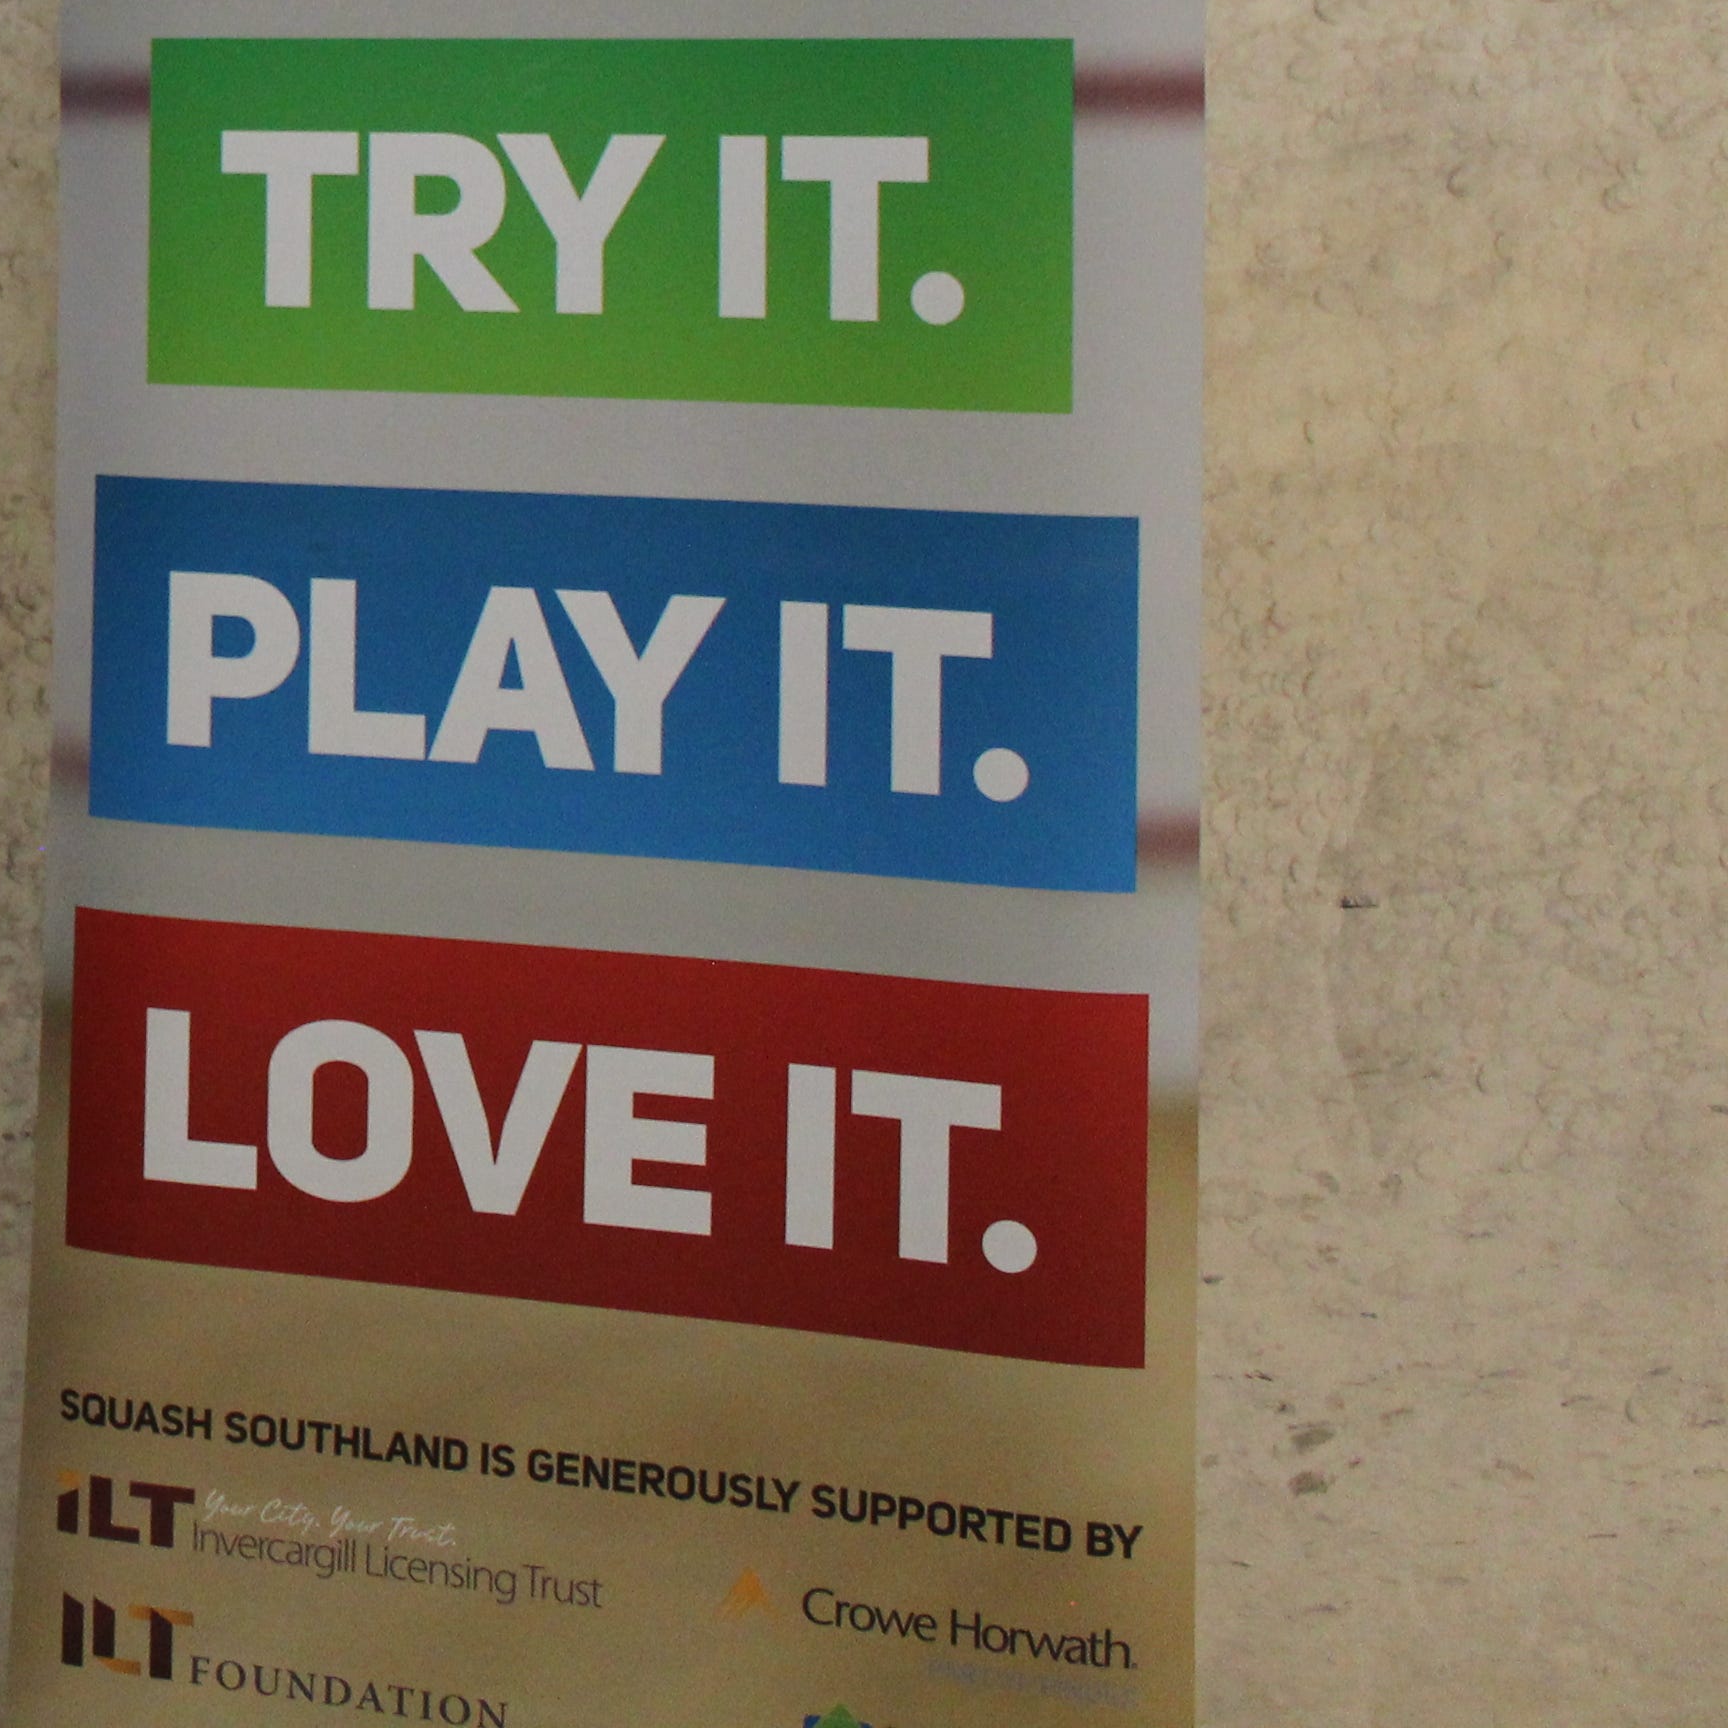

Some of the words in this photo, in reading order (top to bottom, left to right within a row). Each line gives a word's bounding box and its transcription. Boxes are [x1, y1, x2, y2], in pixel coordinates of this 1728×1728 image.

[219, 129, 667, 317] TRY
[716, 135, 965, 326] IT.
[165, 568, 727, 776] PLAY
[778, 598, 1031, 803] IT.
[144, 1006, 716, 1237] LOVE
[785, 1063, 1038, 1274] IT.
[60, 1389, 213, 1440] SQUASH
[225, 1411, 469, 1472] SOUTHLAND
[480, 1442, 516, 1478] IS
[527, 1448, 800, 1513] GENEROUSLY
[811, 1484, 1072, 1553] SUPPORTED
[1086, 1521, 1143, 1559] BY
[202, 1487, 252, 1522] Your
[330, 1504, 383, 1537] Your
[191, 1520, 357, 1580] Invercargill
[365, 1542, 517, 1605] Licensing
[525, 1563, 604, 1609] Trust
[802, 1587, 939, 1642] Crowe
[189, 1654, 509, 1728] FOUNDATION
